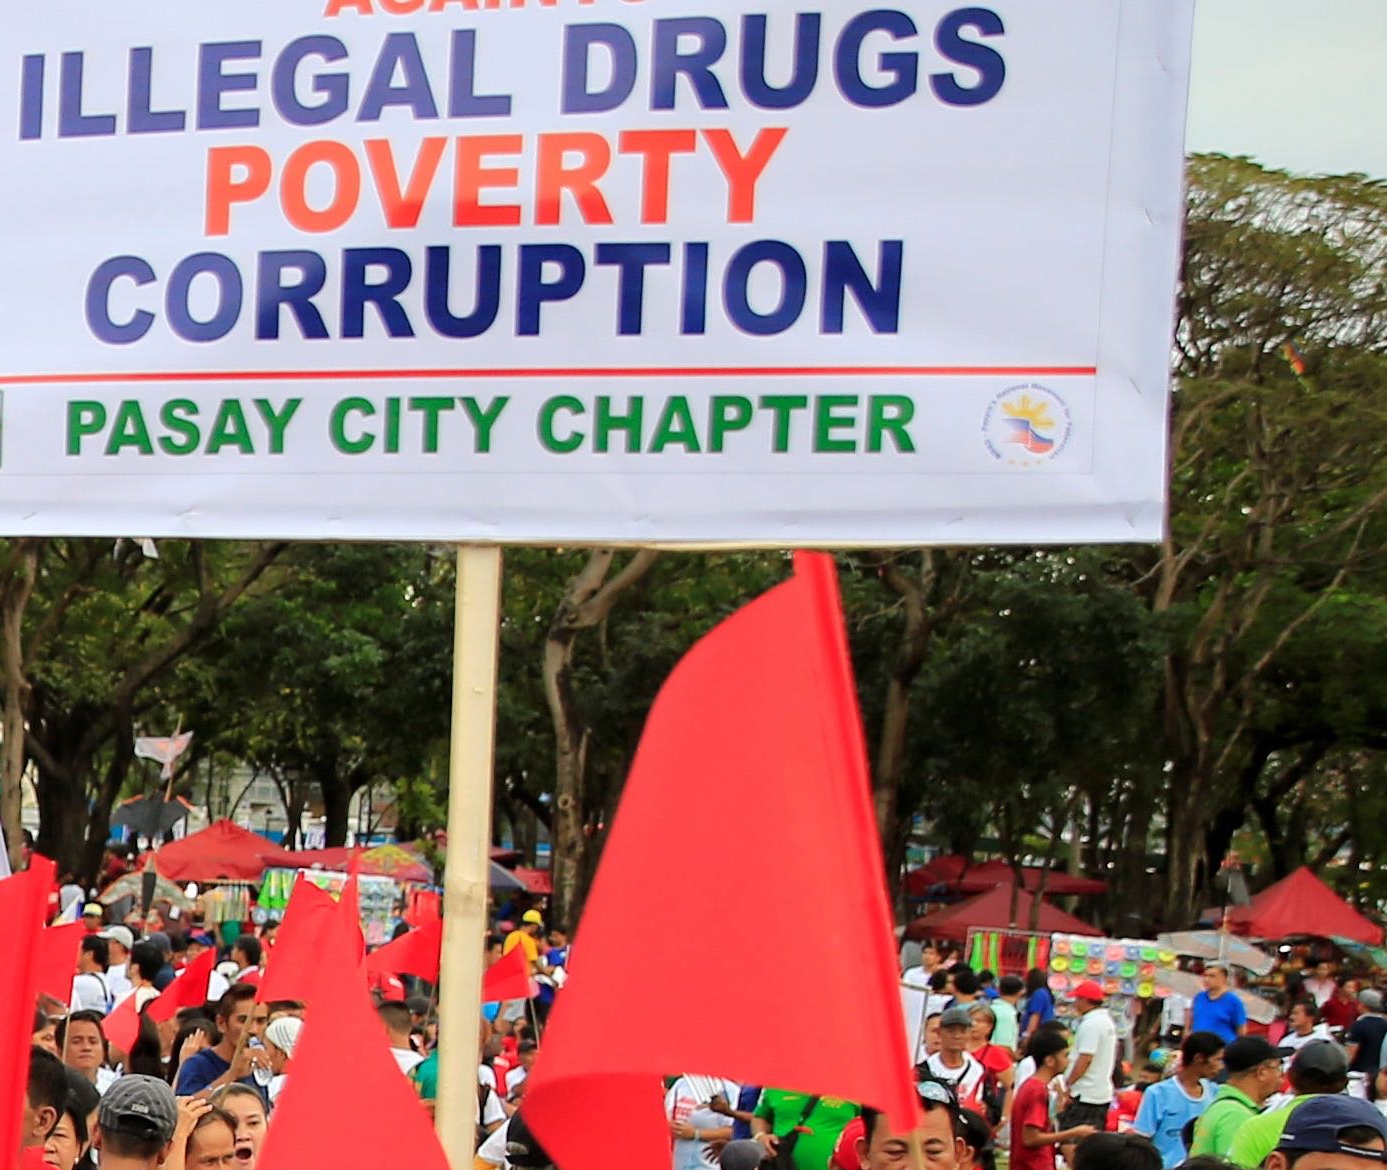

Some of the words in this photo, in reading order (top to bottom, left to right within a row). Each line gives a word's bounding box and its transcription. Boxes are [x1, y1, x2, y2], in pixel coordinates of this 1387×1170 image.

[18, 28, 512, 141] ILLEGAL
[560, 8, 1006, 115] DRUGS
[204, 127, 789, 237] POVERTY
[84, 239, 903, 345] CORRUPTION
[66, 398, 303, 456] PASAY
[328, 396, 511, 455] CITY
[537, 394, 916, 455] CHAPTER
